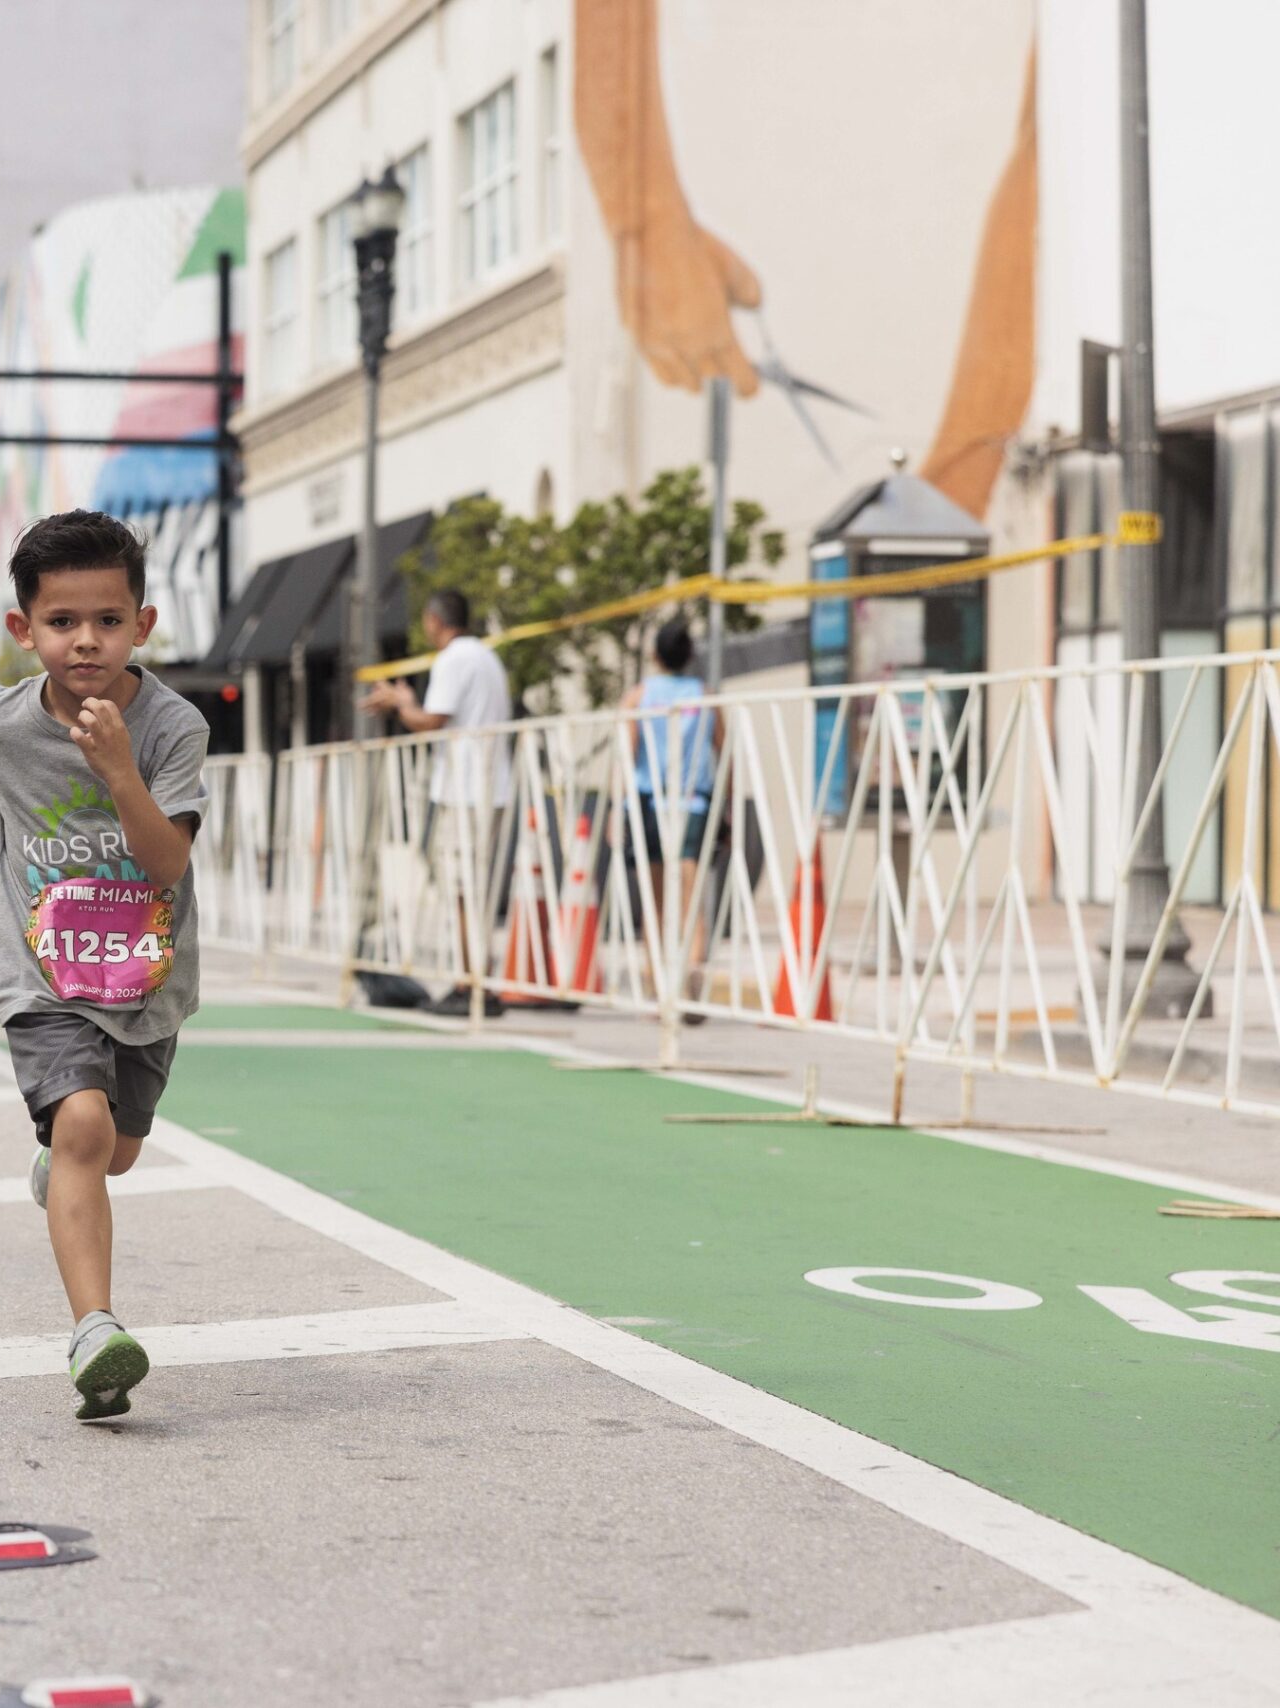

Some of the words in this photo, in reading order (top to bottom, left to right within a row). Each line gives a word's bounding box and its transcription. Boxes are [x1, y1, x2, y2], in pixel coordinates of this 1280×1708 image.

[23, 834, 92, 865] KIDS
[65, 885, 97, 901] TIME
[99, 887, 155, 904] MIAMI
[35, 927, 164, 965] 41254
[63, 983, 102, 996] JANUARY
[116, 988, 142, 998] 2024
